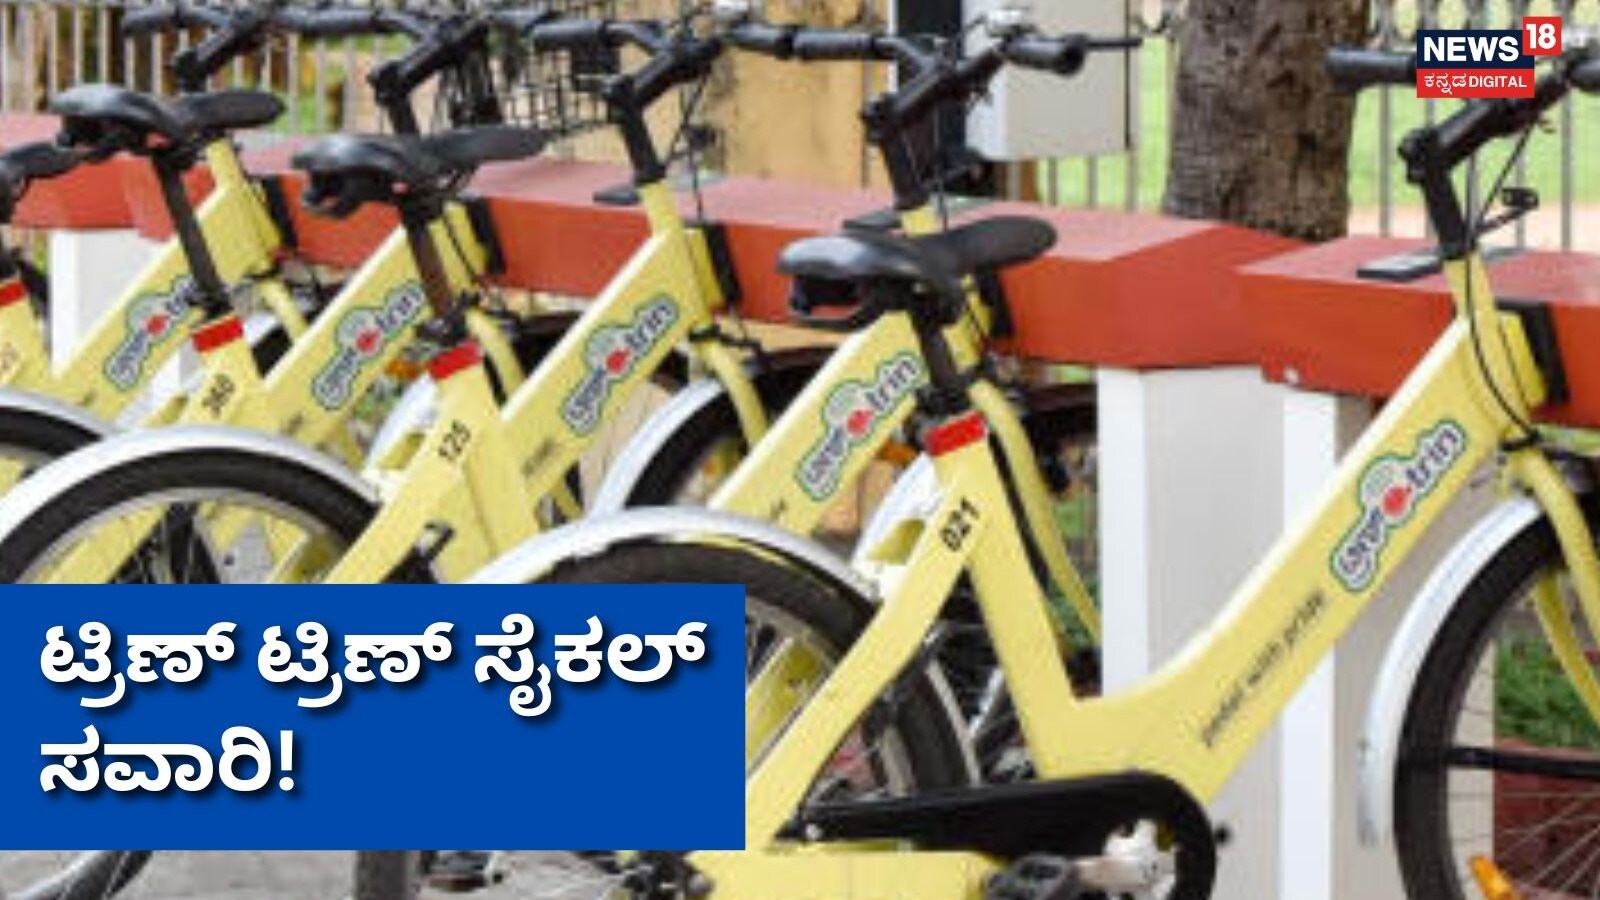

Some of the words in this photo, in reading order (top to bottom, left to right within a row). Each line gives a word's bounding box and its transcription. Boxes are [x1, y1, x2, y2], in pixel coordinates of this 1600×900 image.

[865, 358, 919, 412] trin
[1405, 427, 1461, 490] trin
[939, 495, 981, 552] 021
